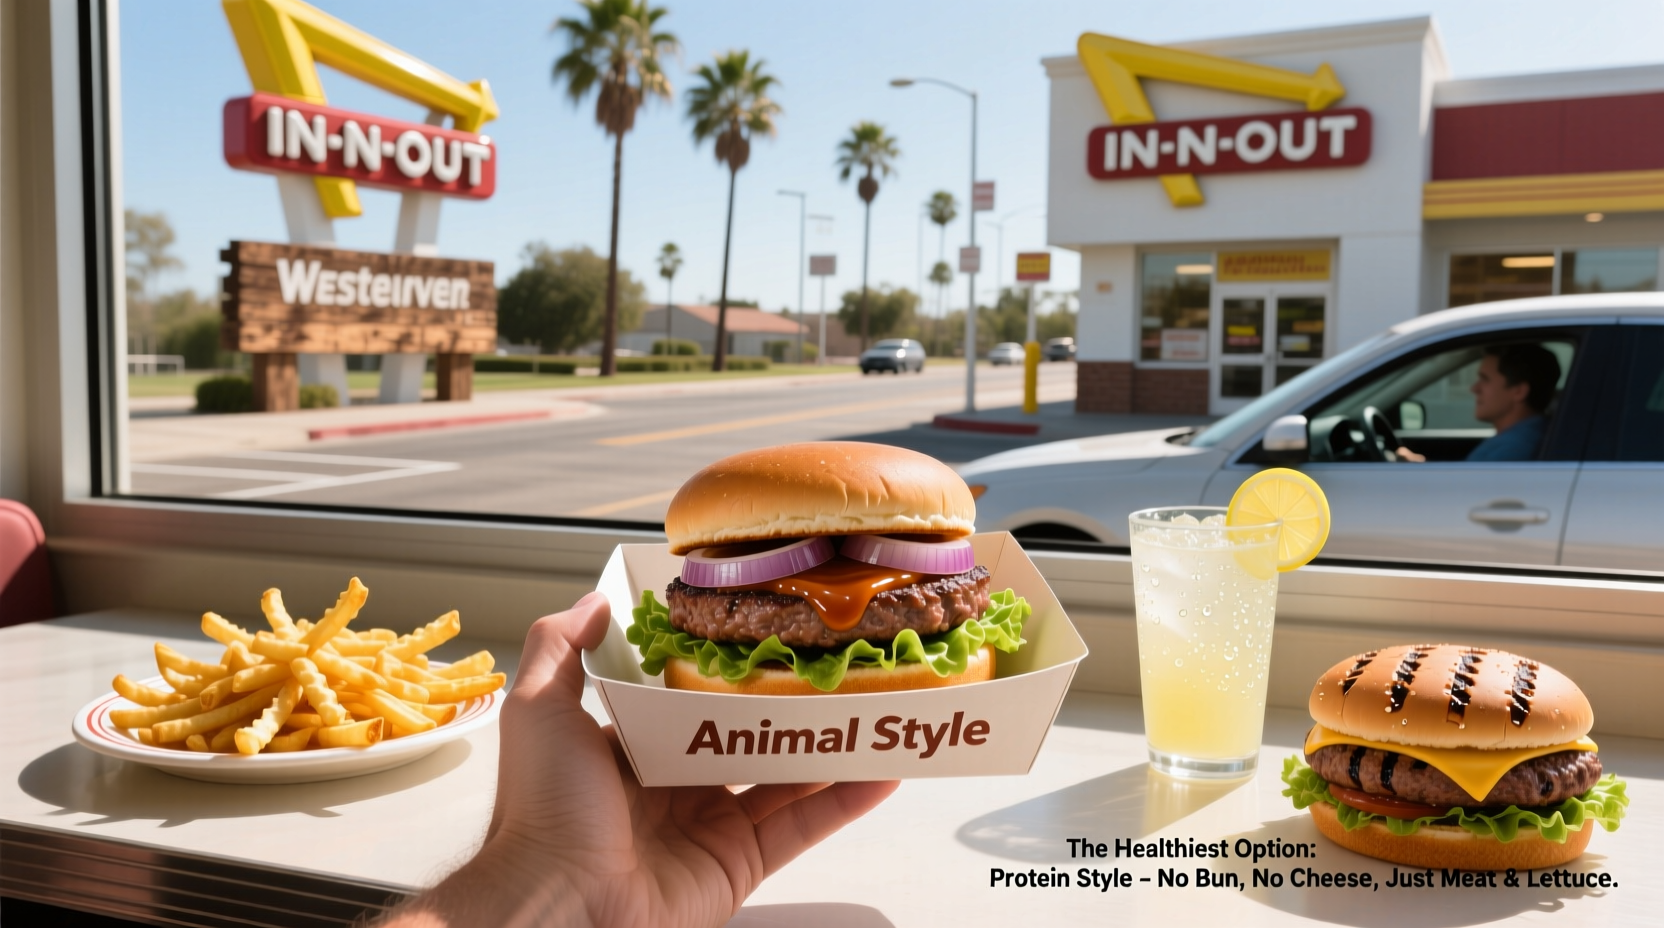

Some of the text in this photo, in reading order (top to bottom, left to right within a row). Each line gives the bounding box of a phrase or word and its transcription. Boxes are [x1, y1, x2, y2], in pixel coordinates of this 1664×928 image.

[267, 106, 491, 186] IN-N-OUT
[1104, 115, 1357, 171] IN-N-OUT
[686, 711, 991, 759] Animal Style
